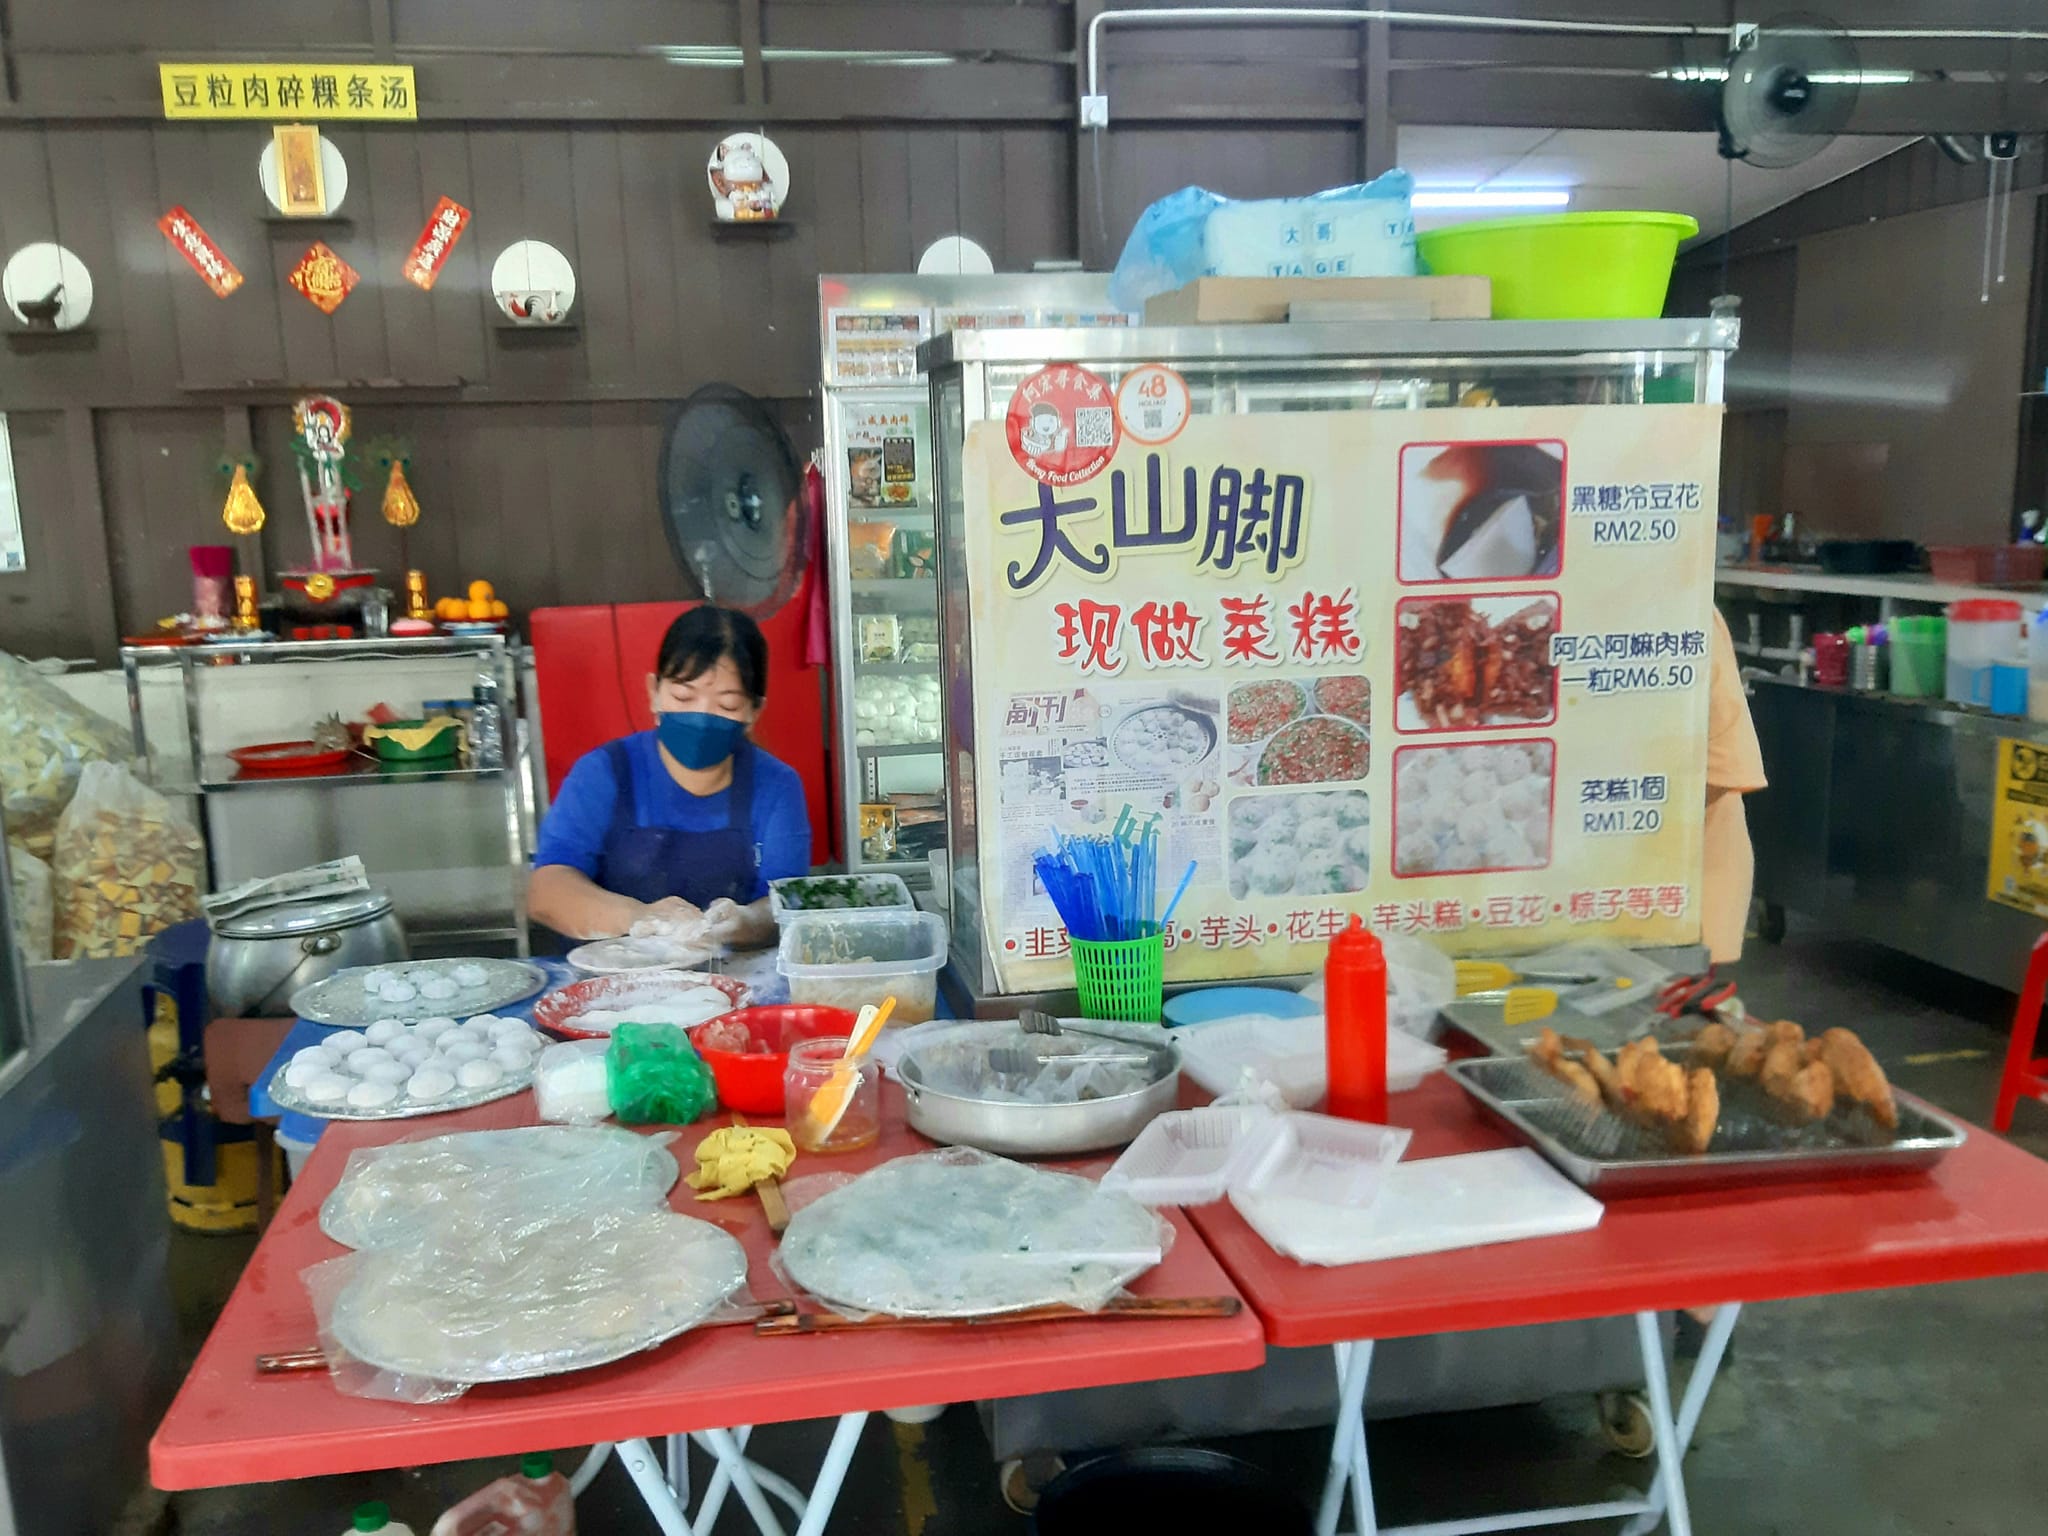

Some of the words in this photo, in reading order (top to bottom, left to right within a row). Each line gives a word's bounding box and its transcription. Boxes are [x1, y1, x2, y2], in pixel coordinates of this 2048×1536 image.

[172, 73, 408, 109] 豆粒肉碎粿条汤
[1138, 374, 1167, 398] 48
[1047, 470, 1068, 483] Food
[1069, 455, 1105, 482] Collection
[1572, 483, 1700, 512] 黑糖冷豆花
[1000, 453, 1304, 589] 大山脚
[1594, 520, 1676, 542] RM2.50
[1054, 587, 1360, 671] 现做菜糕
[1584, 809, 1659, 832] RM1.20
[1201, 914, 1262, 947] 芋头
[1286, 907, 1344, 941] 花生
[1373, 900, 1462, 934] 芋头糕
[1486, 894, 1545, 925] 豆花
